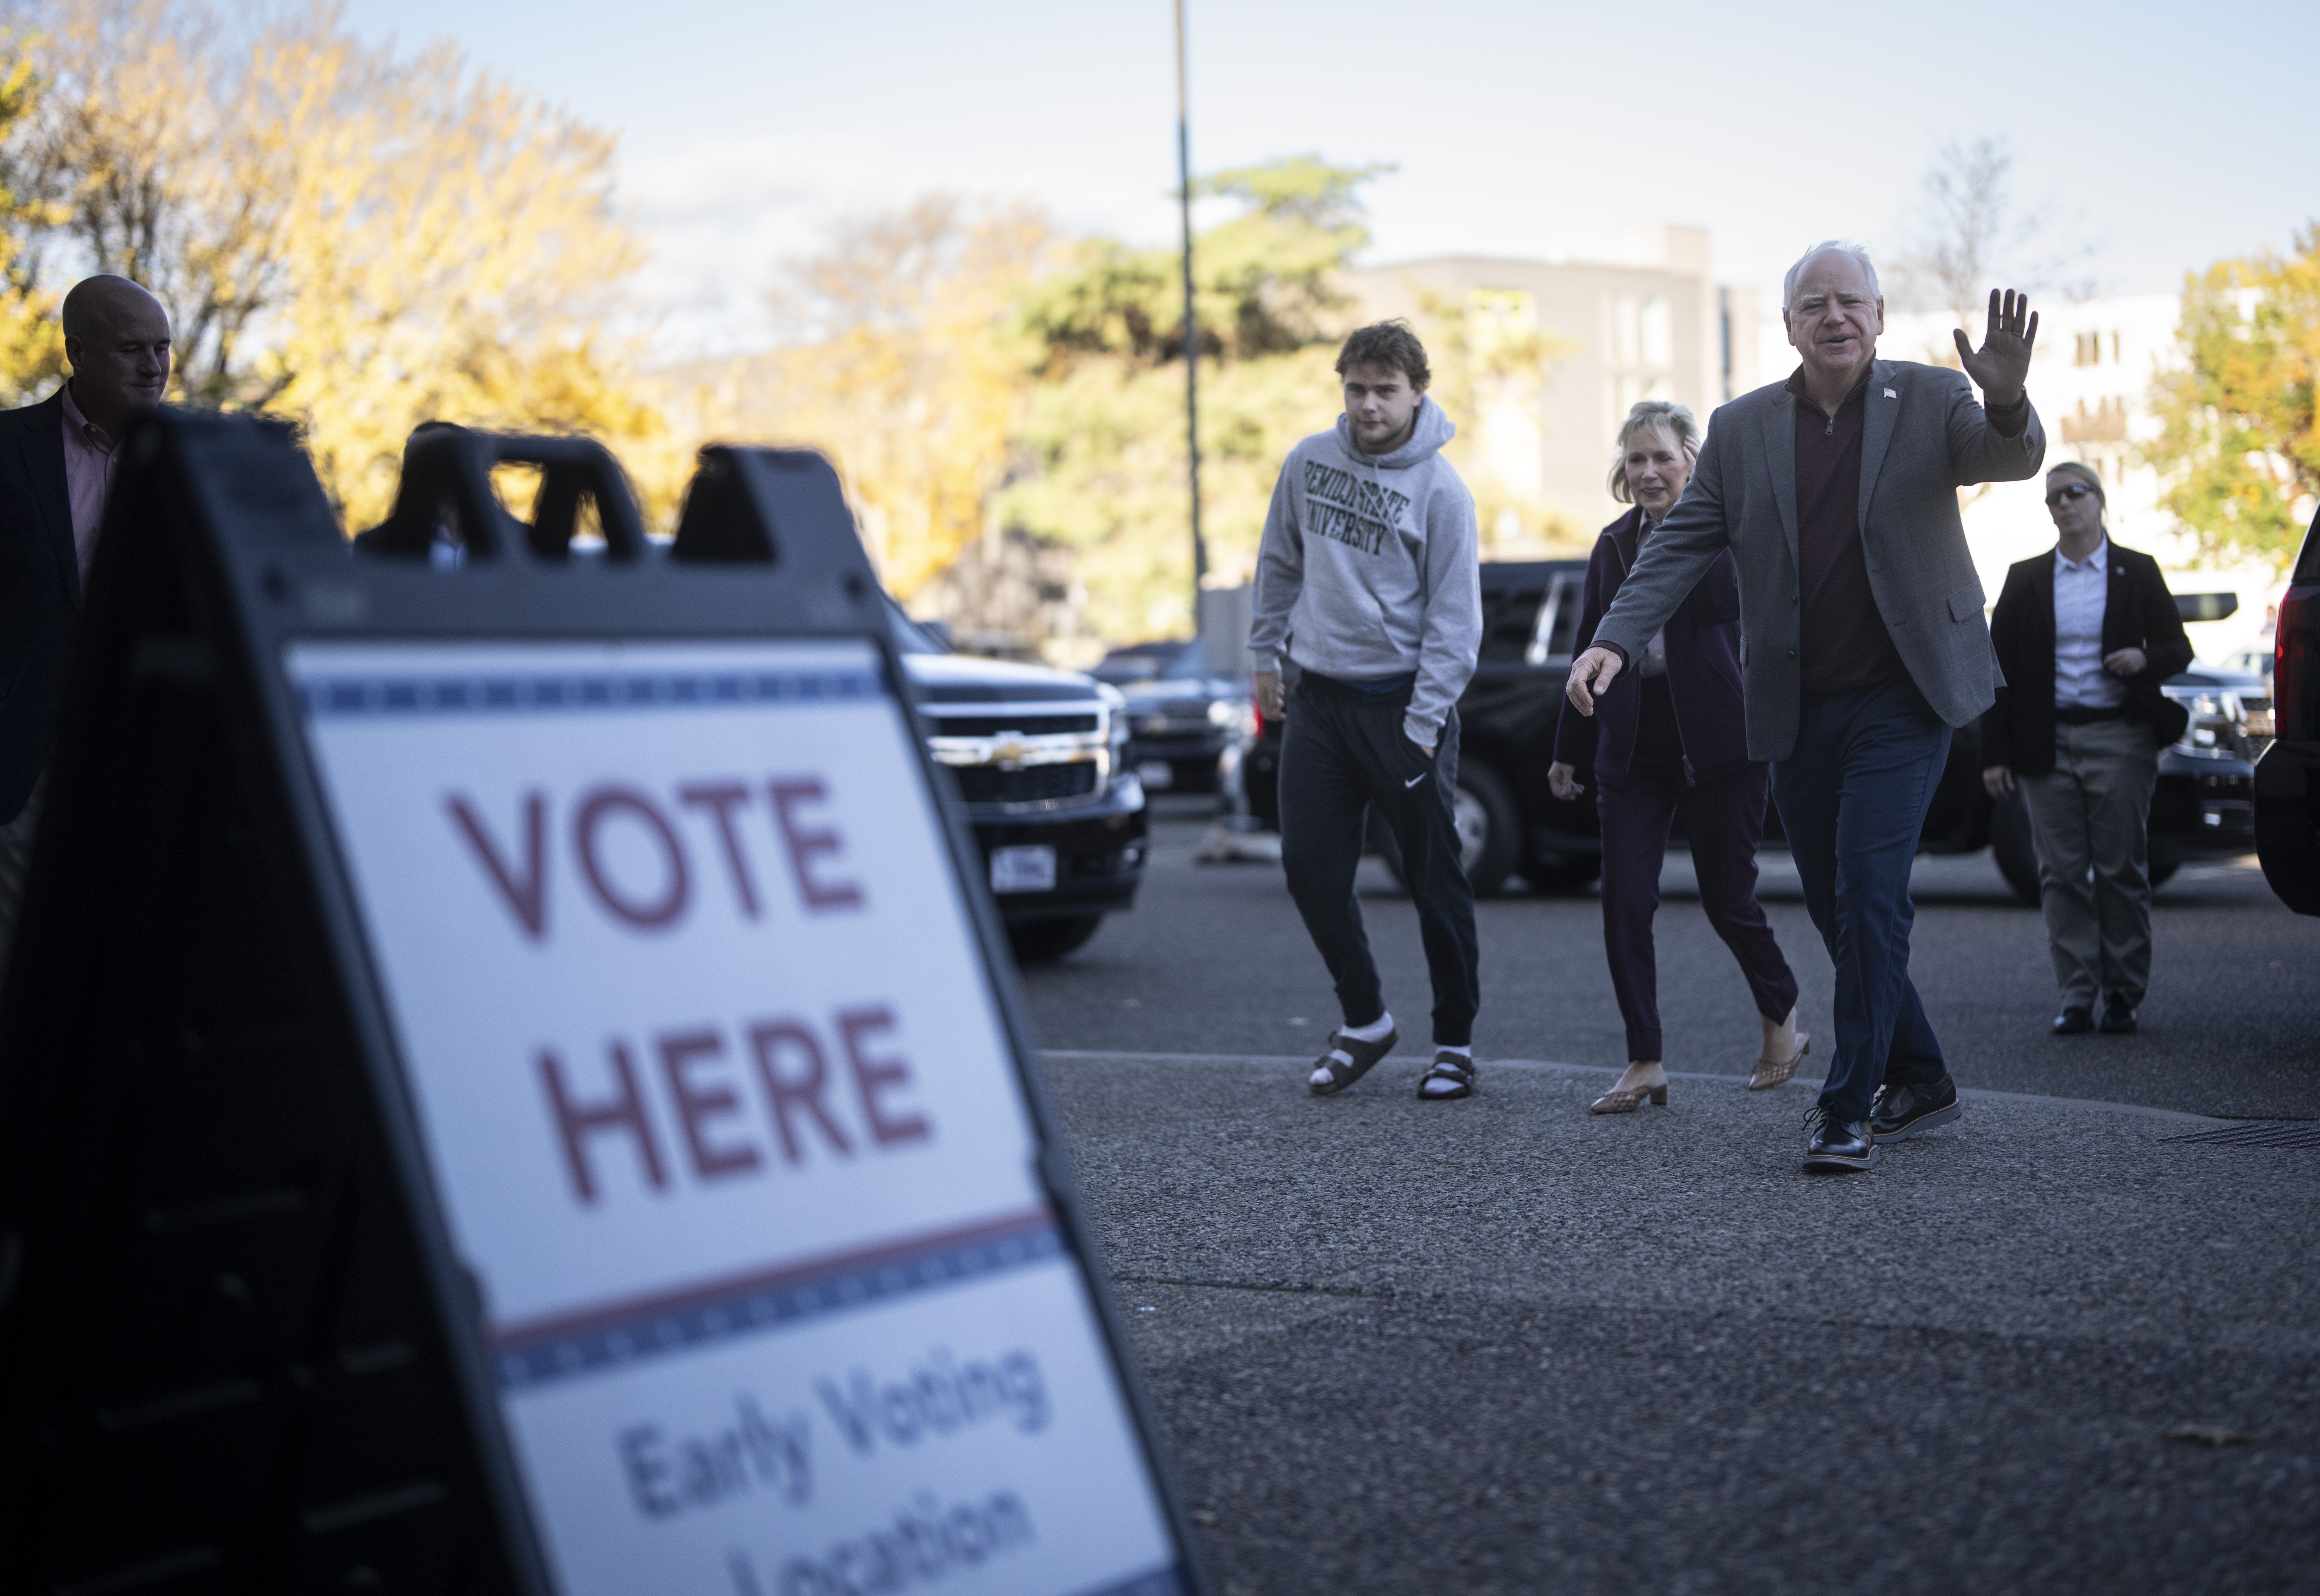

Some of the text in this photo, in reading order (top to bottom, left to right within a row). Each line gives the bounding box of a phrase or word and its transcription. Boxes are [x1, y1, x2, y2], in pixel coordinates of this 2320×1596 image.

[1359, 480, 1410, 524] STATE
[443, 774, 865, 943] VOTE
[537, 1004, 933, 1206] HERE
[616, 1346, 1053, 1520] Early Voting
